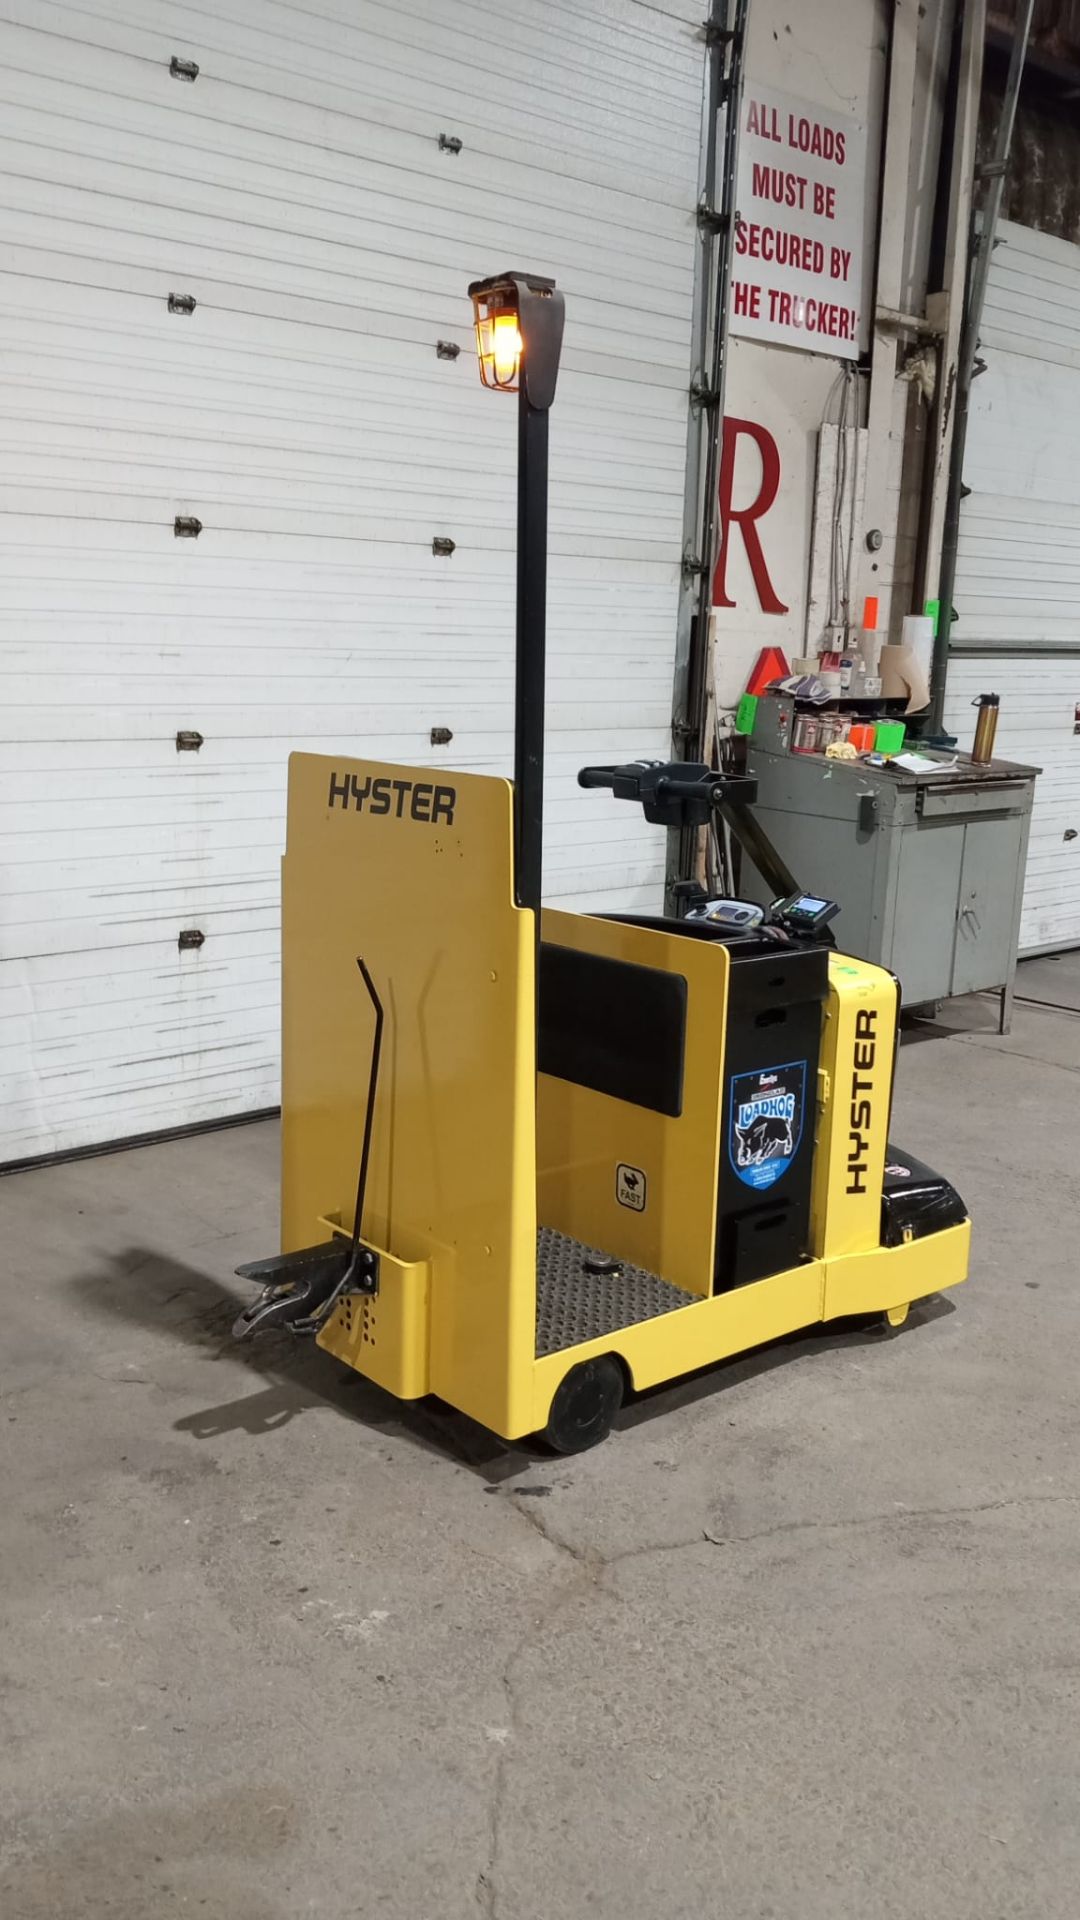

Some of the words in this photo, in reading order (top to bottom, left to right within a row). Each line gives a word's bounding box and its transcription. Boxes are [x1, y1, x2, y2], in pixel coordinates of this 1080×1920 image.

[746, 100, 782, 143] ALL
[789, 114, 846, 165] LOADS
[752, 163, 807, 209] MUST
[813, 182, 836, 219] BE
[735, 221, 824, 274] SECURED
[830, 247, 851, 281] BY
[731, 281, 761, 319] HE
[768, 288, 856, 341] TRUCKER!
[712, 416, 789, 615] R
[328, 772, 457, 825] HYSTER
[739, 1094, 795, 1129] LOADHOG
[846, 1009, 877, 1194] HYSTER
[620, 1188, 641, 1205] FAST
